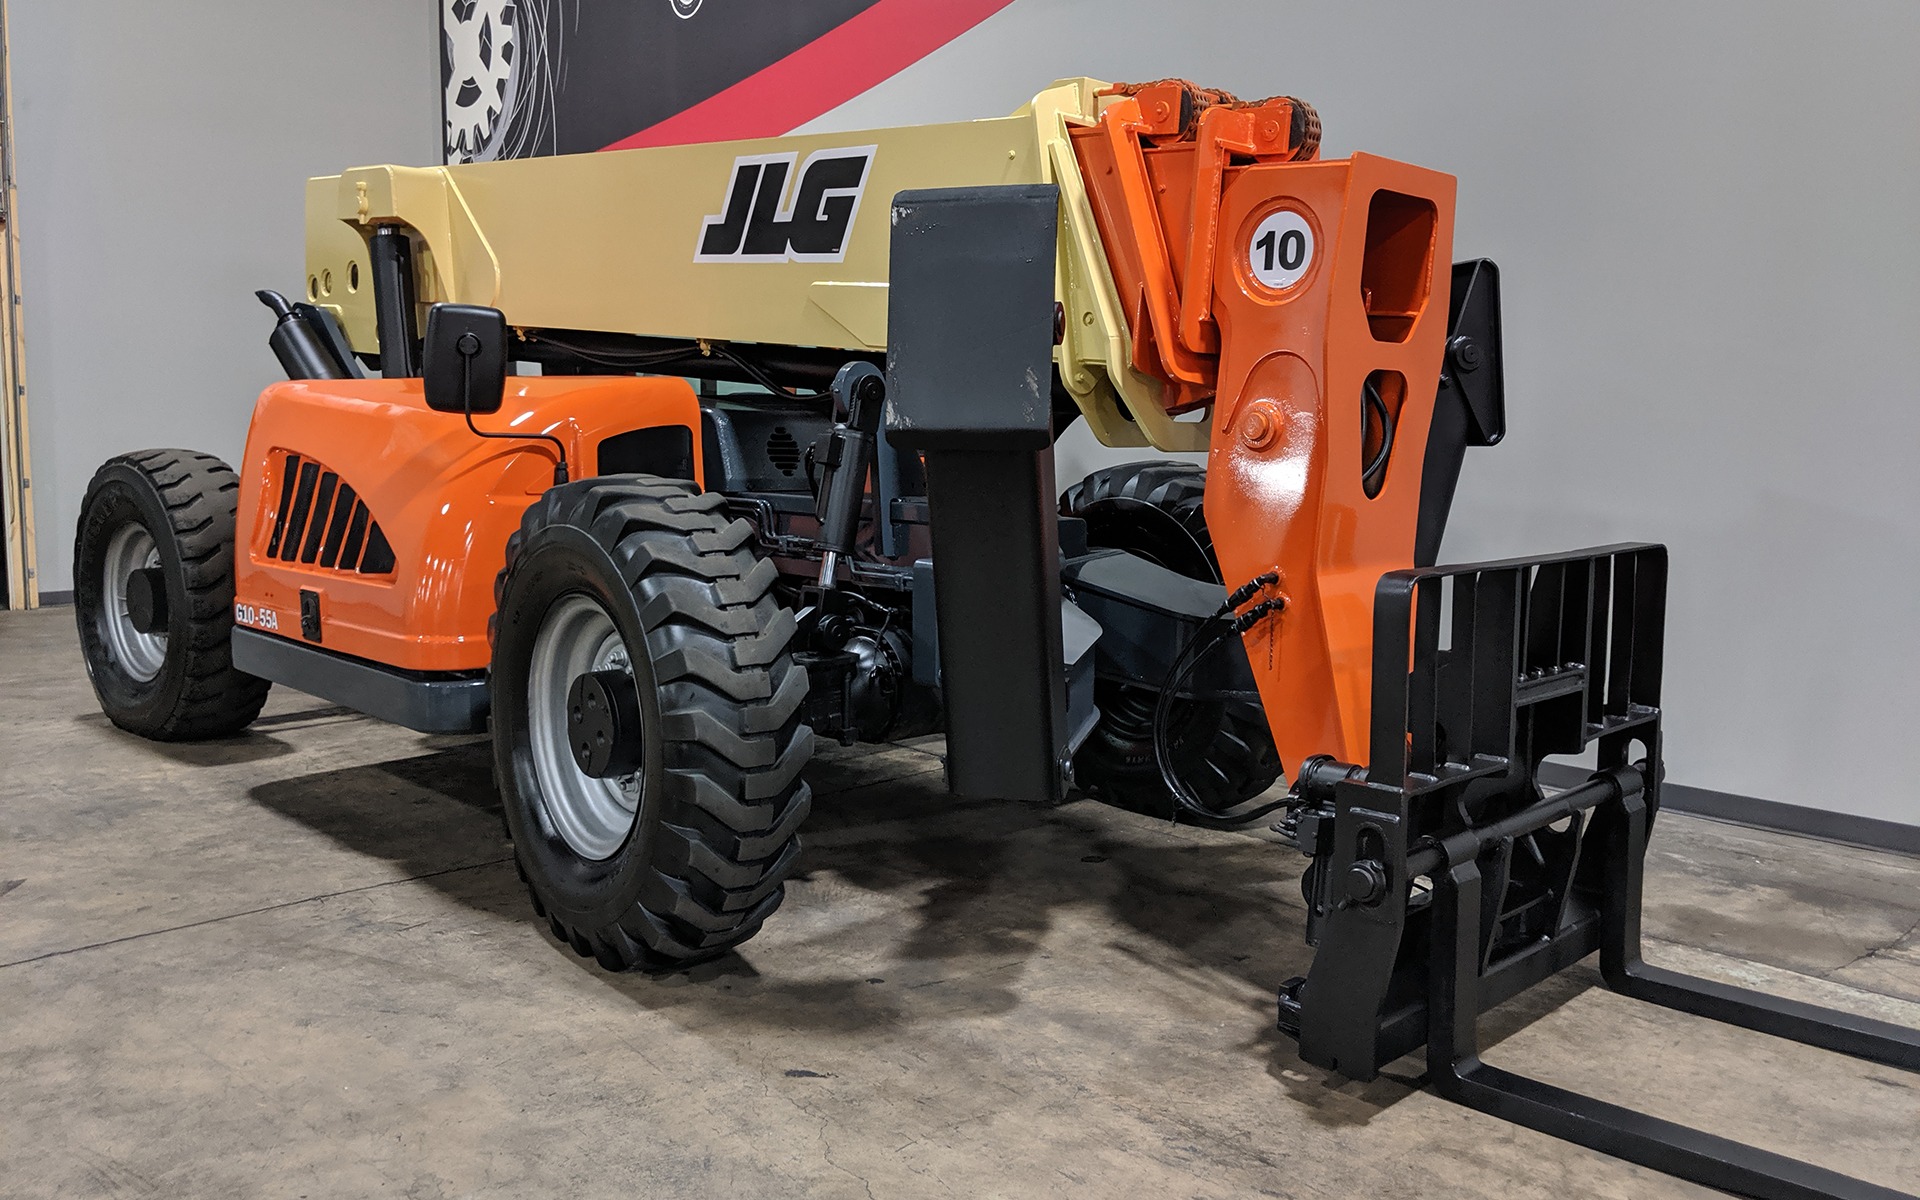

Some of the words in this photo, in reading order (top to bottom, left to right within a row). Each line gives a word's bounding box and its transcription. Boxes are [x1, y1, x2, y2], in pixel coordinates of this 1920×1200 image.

[698, 153, 870, 256] JLG
[1256, 229, 1306, 271] 10
[235, 603, 278, 630] G10-55A
